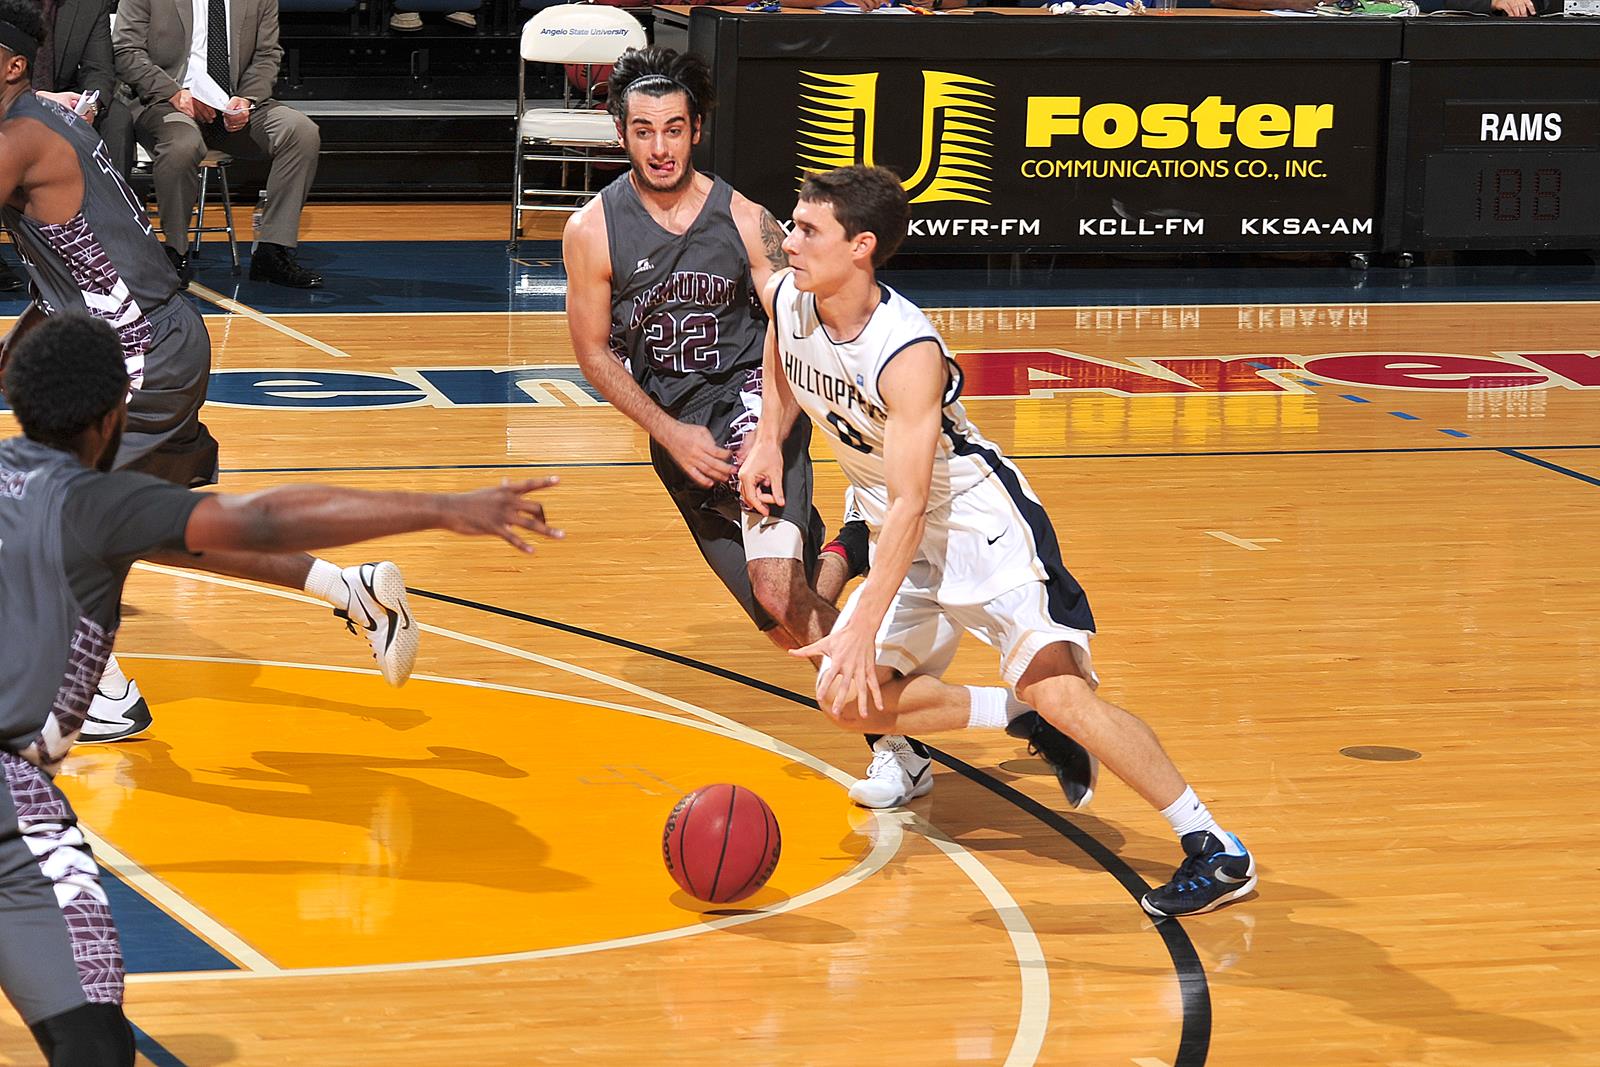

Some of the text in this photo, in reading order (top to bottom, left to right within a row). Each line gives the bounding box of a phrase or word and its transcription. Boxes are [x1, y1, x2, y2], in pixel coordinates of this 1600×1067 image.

[540, 28, 568, 36] Angelo
[590, 28, 629, 37] University
[1025, 96, 1334, 149] Foster
[1480, 112, 1562, 141] RAMS
[1021, 159, 1327, 180] COMMUNICATIONS CO., INC.
[907, 218, 1373, 236] KWFR-FM KCLL-FM KKSA-AM
[641, 313, 720, 373] 22
